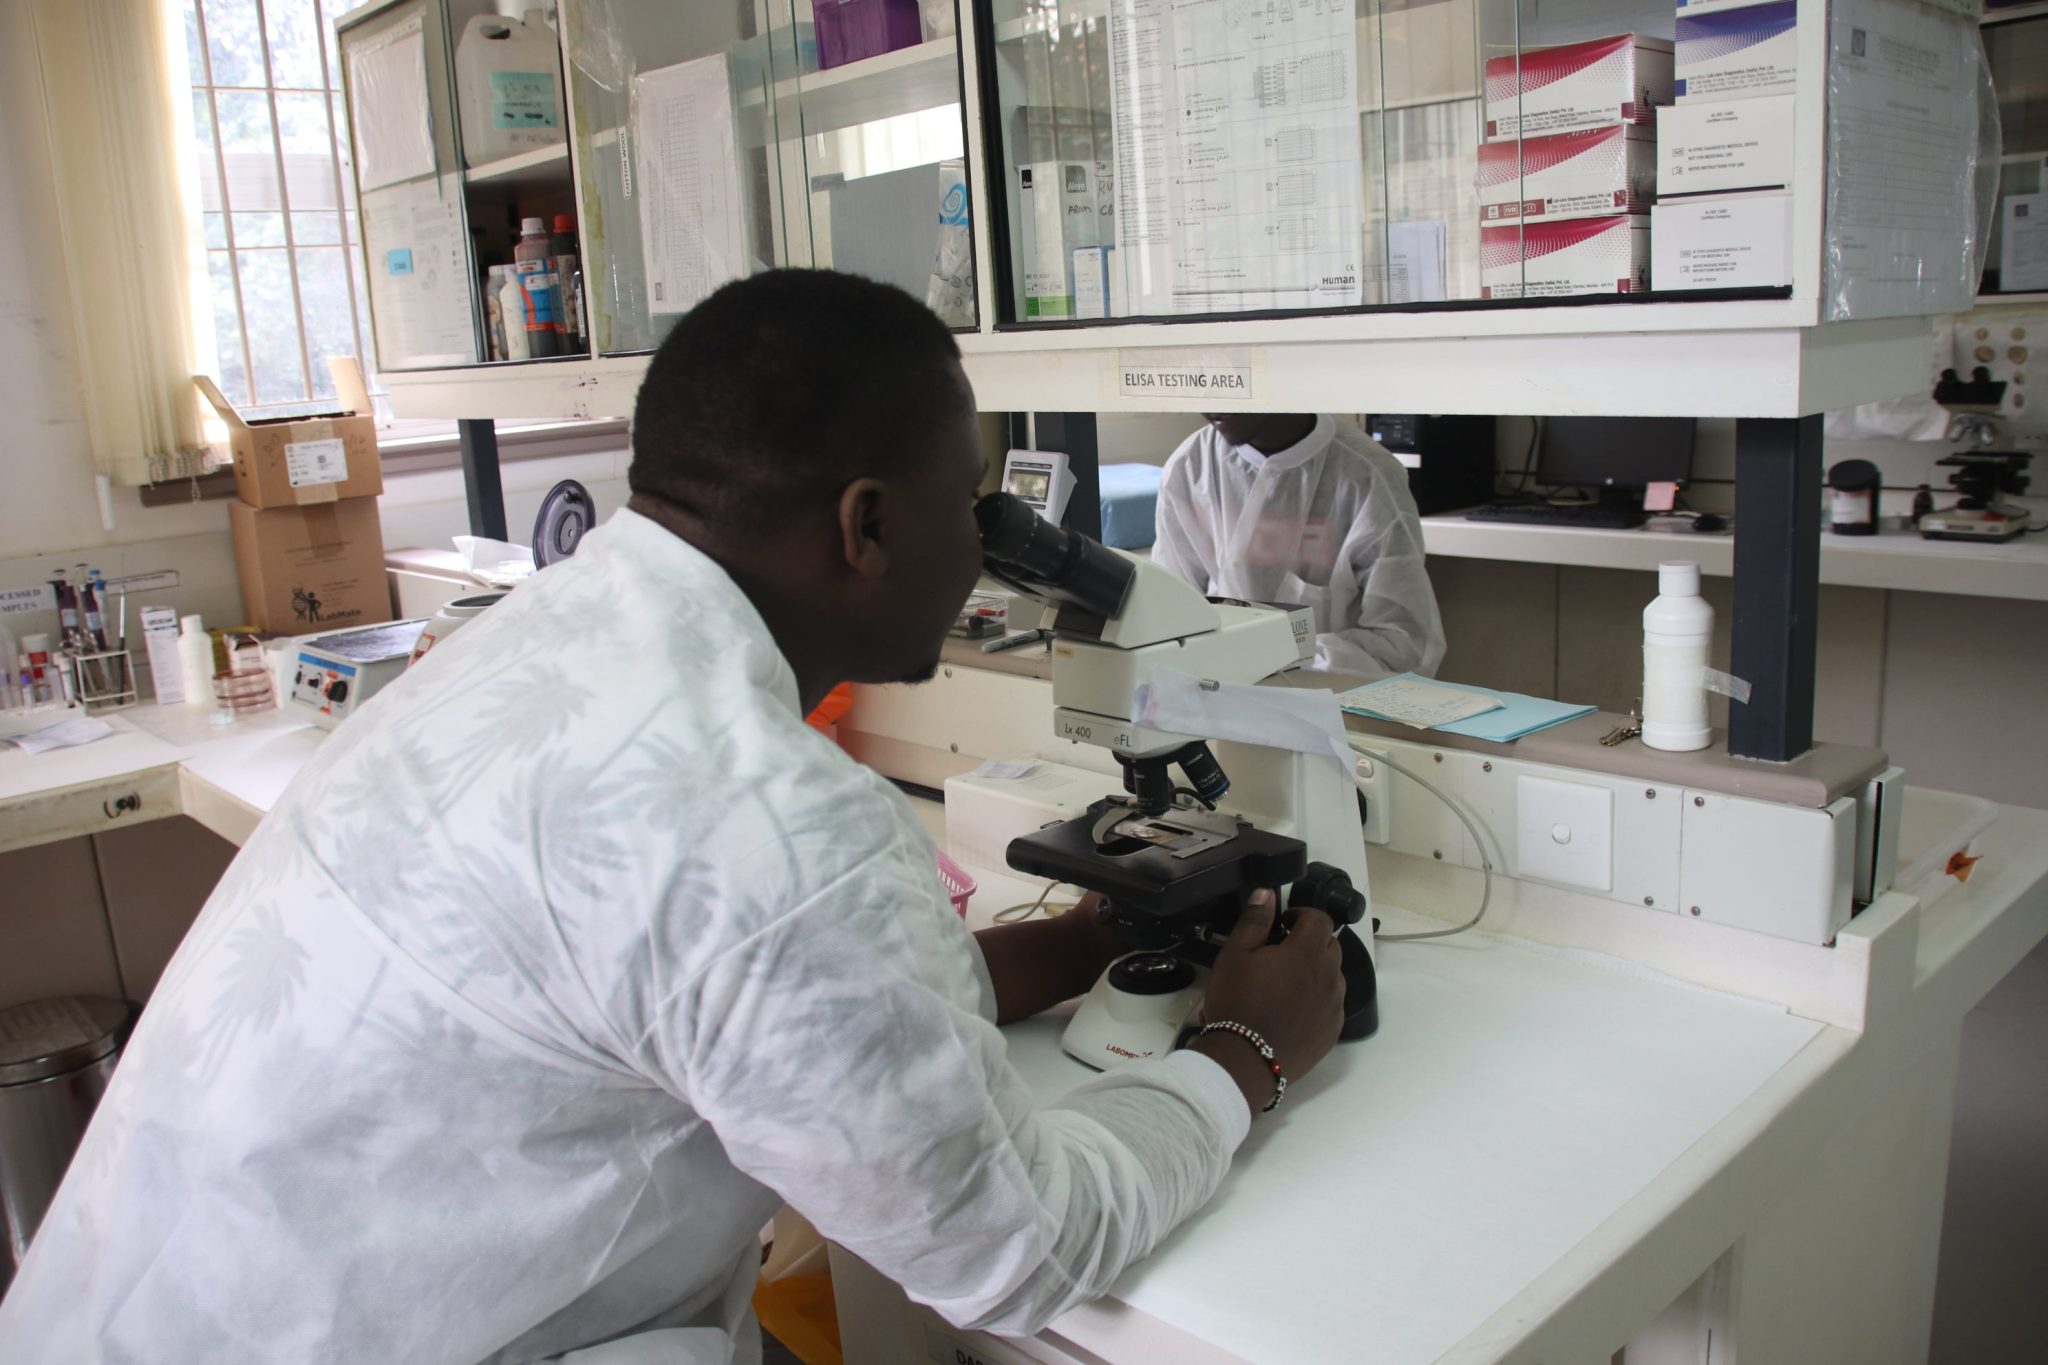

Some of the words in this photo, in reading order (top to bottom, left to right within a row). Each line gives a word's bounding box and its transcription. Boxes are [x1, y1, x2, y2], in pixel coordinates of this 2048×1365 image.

[623, 160, 631, 195] COTTON
[1068, 205, 1091, 216] FROM
[1322, 274, 1355, 285] Human
[1125, 373, 1155, 386] ELISA
[1157, 373, 1207, 387] TESTING
[1211, 374, 1244, 388] AREA
[1065, 723, 1073, 734] Lx
[1075, 726, 1092, 739] 400
